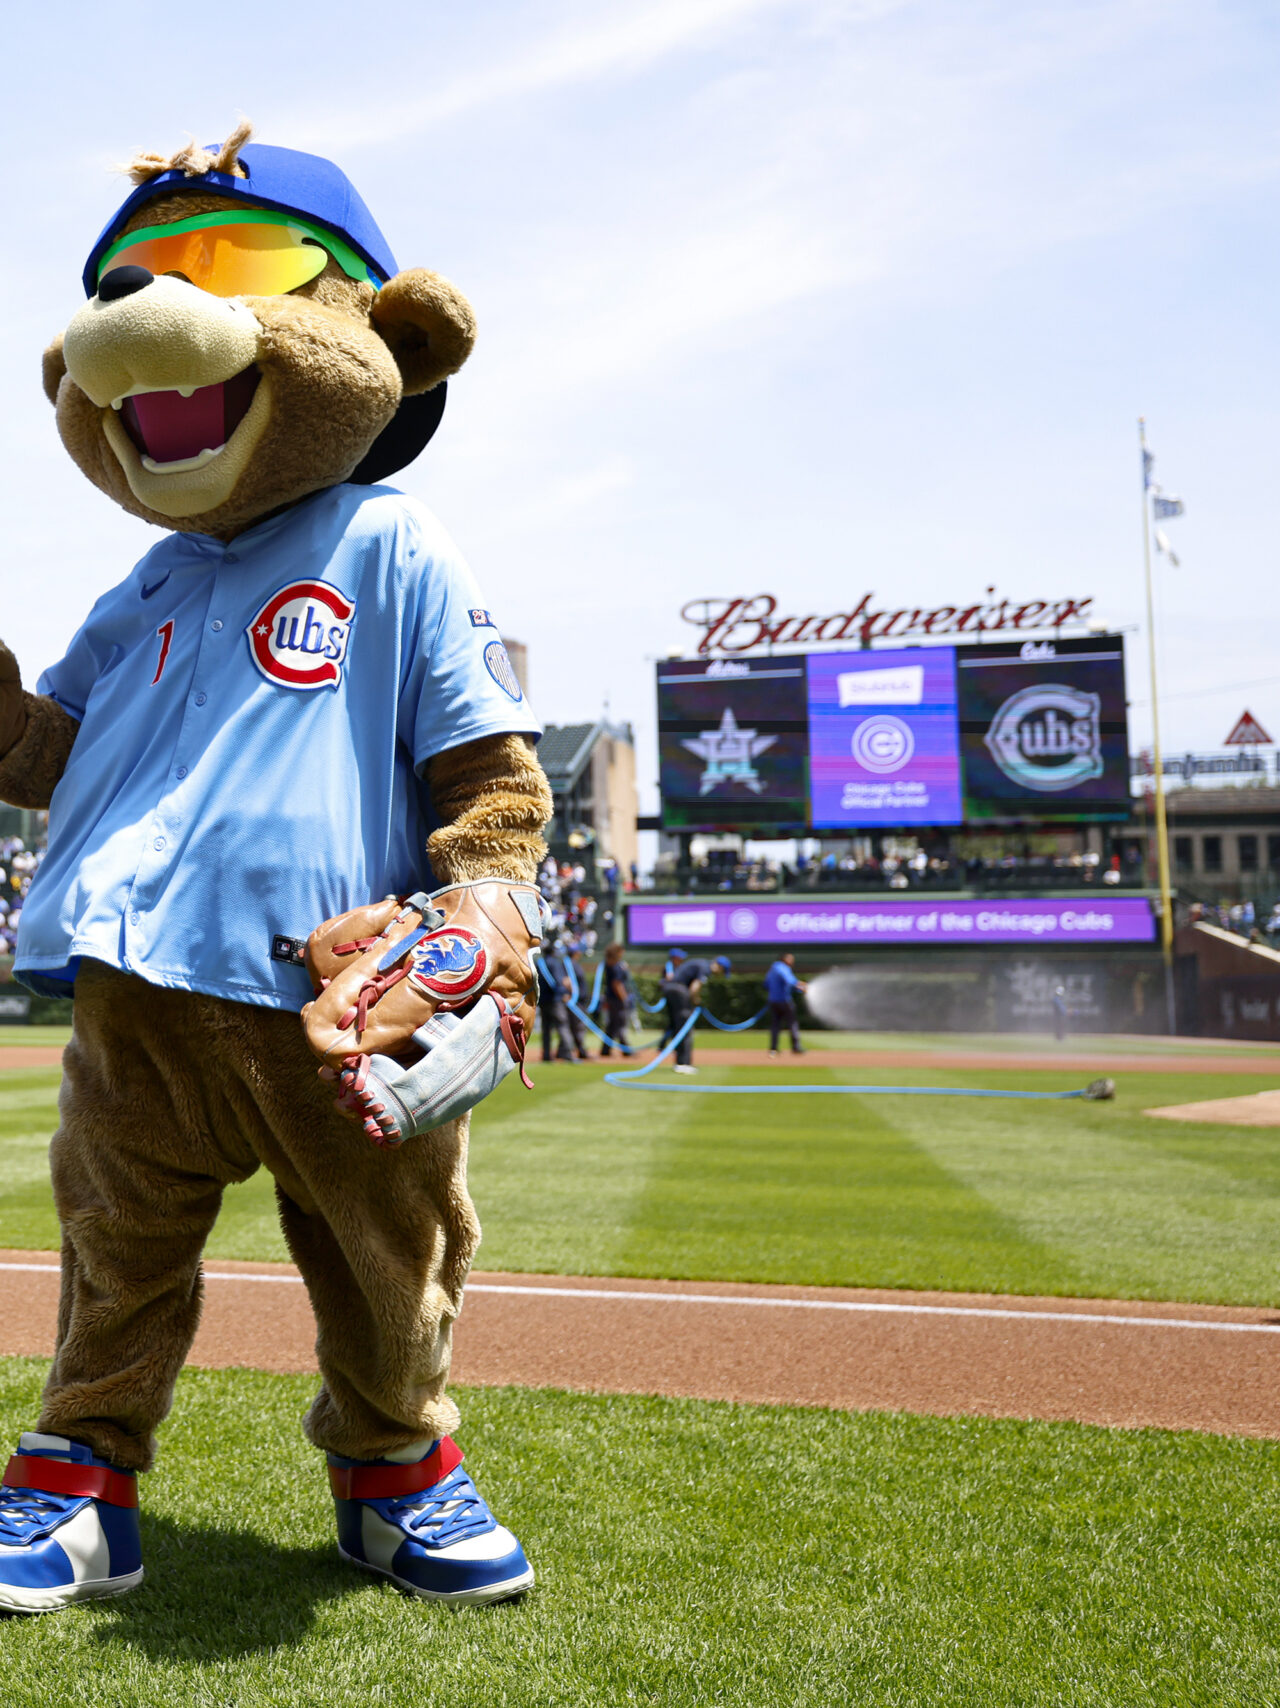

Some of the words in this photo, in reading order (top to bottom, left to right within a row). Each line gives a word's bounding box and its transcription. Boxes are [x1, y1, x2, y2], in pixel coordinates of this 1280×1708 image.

[150, 618, 175, 687] 1
[681, 585, 1095, 654] Budweiser
[776, 912, 843, 933] Official
[845, 912, 914, 932] Partner
[916, 911, 938, 932] of
[941, 911, 974, 932] the
[976, 911, 1058, 935] Chicago
[1060, 910, 1114, 931] Cubs
